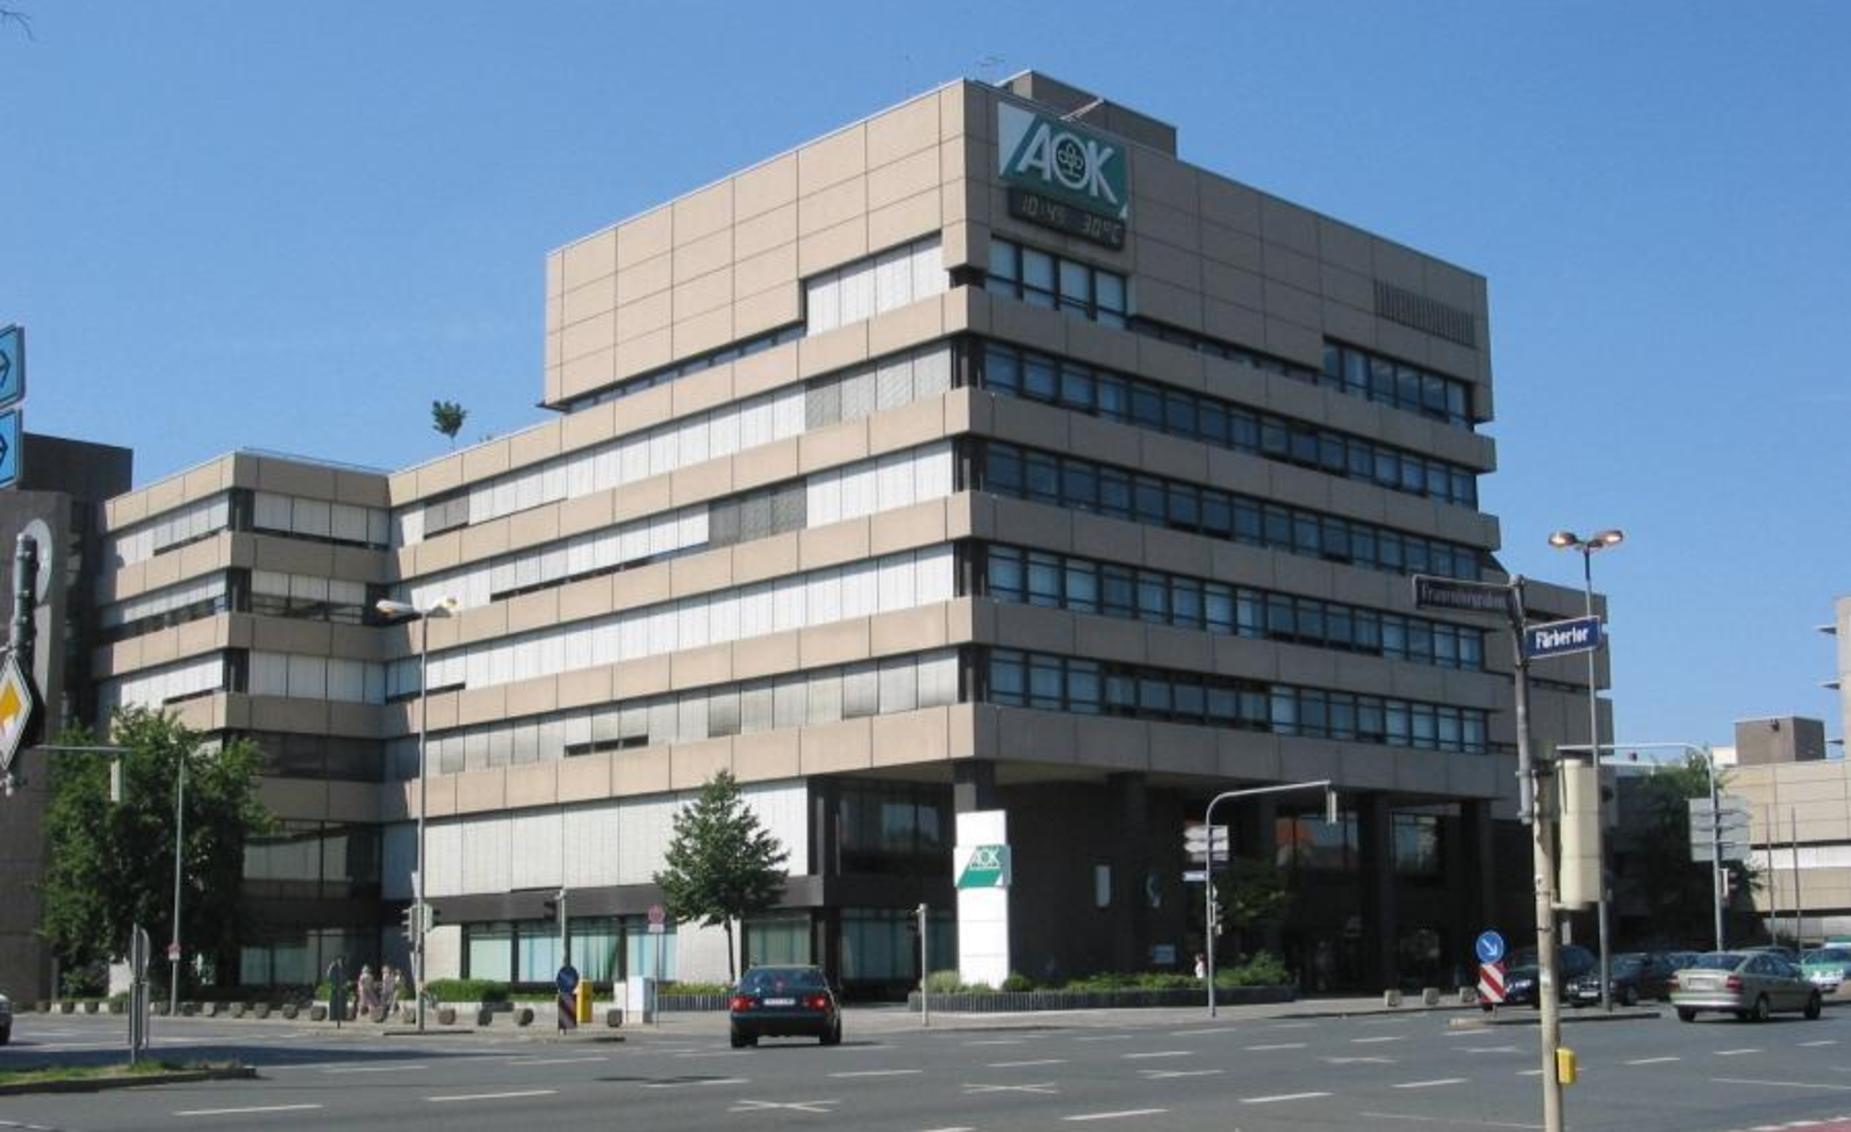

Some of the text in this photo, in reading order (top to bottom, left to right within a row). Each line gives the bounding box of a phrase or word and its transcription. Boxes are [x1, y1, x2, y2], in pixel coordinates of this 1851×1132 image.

[1016, 122, 1118, 204] AOK
[1535, 626, 1589, 650] Färbertor
[969, 847, 1002, 871] AOK
